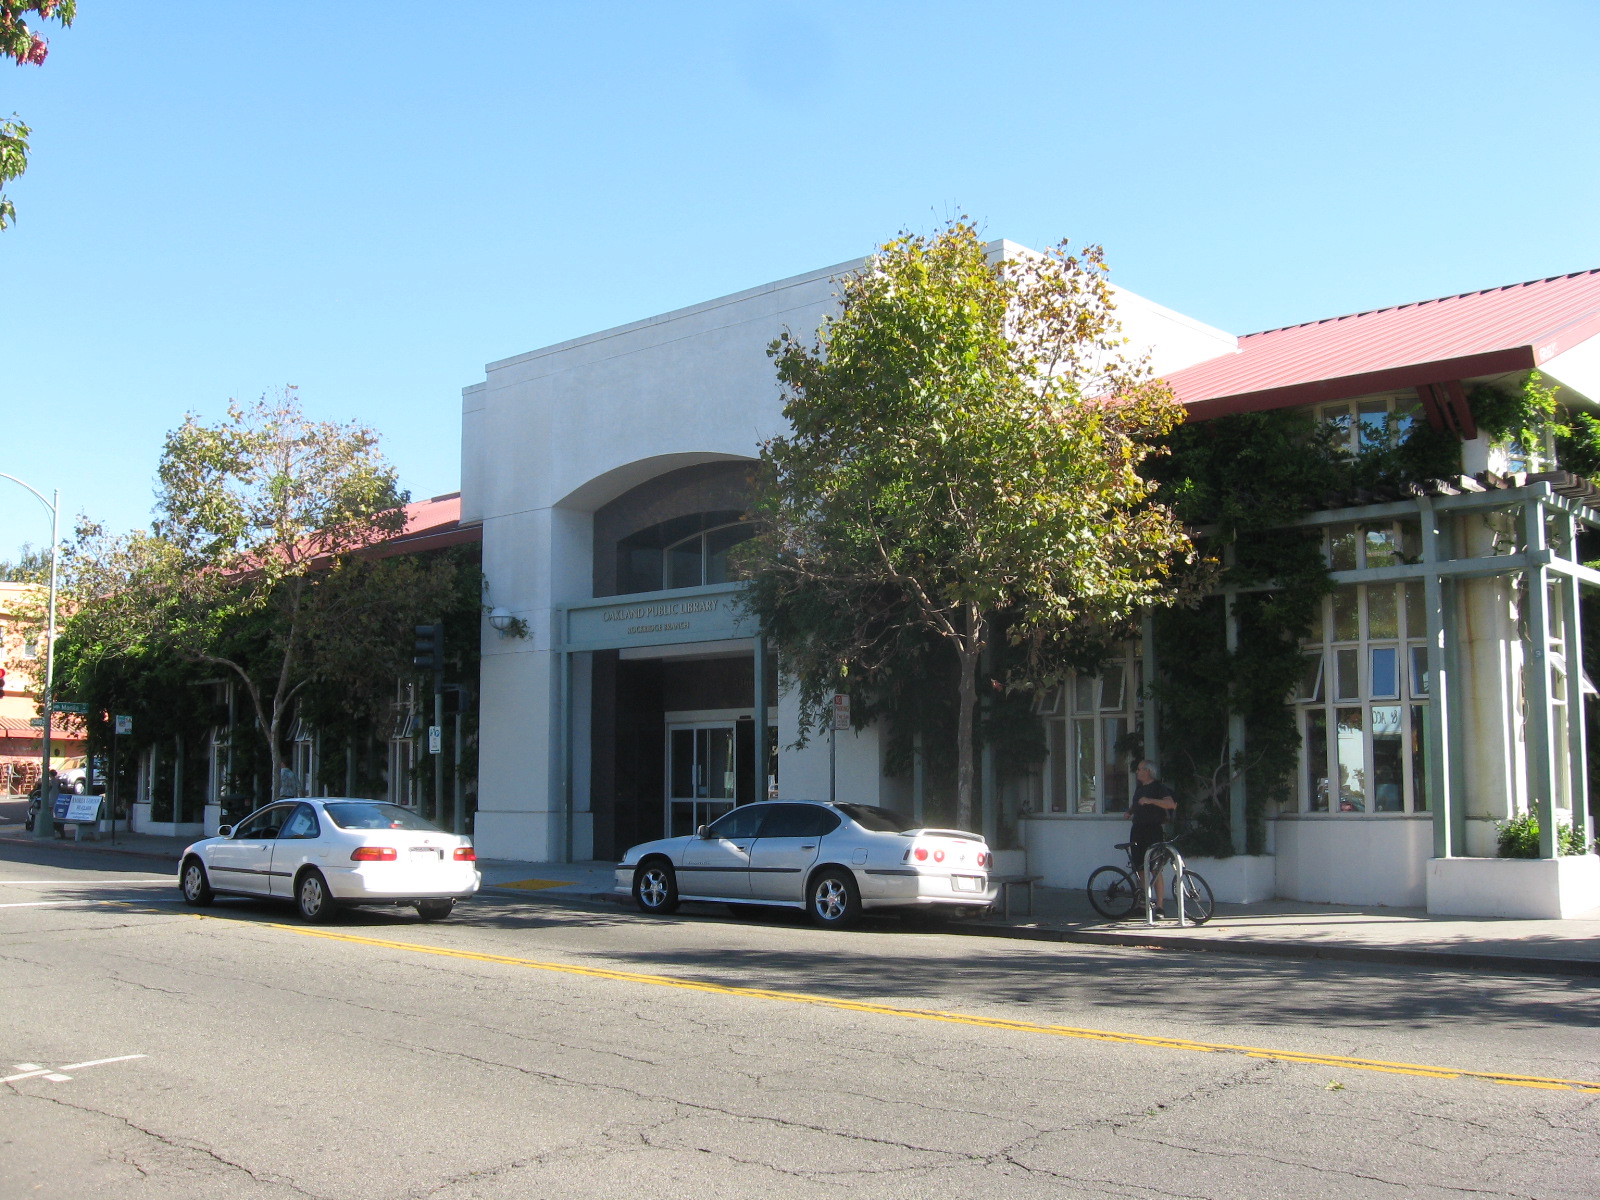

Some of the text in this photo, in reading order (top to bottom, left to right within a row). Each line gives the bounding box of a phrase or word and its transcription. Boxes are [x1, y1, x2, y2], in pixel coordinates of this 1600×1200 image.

[603, 600, 718, 622] OAKLAND PUBLIC LIBRARY
